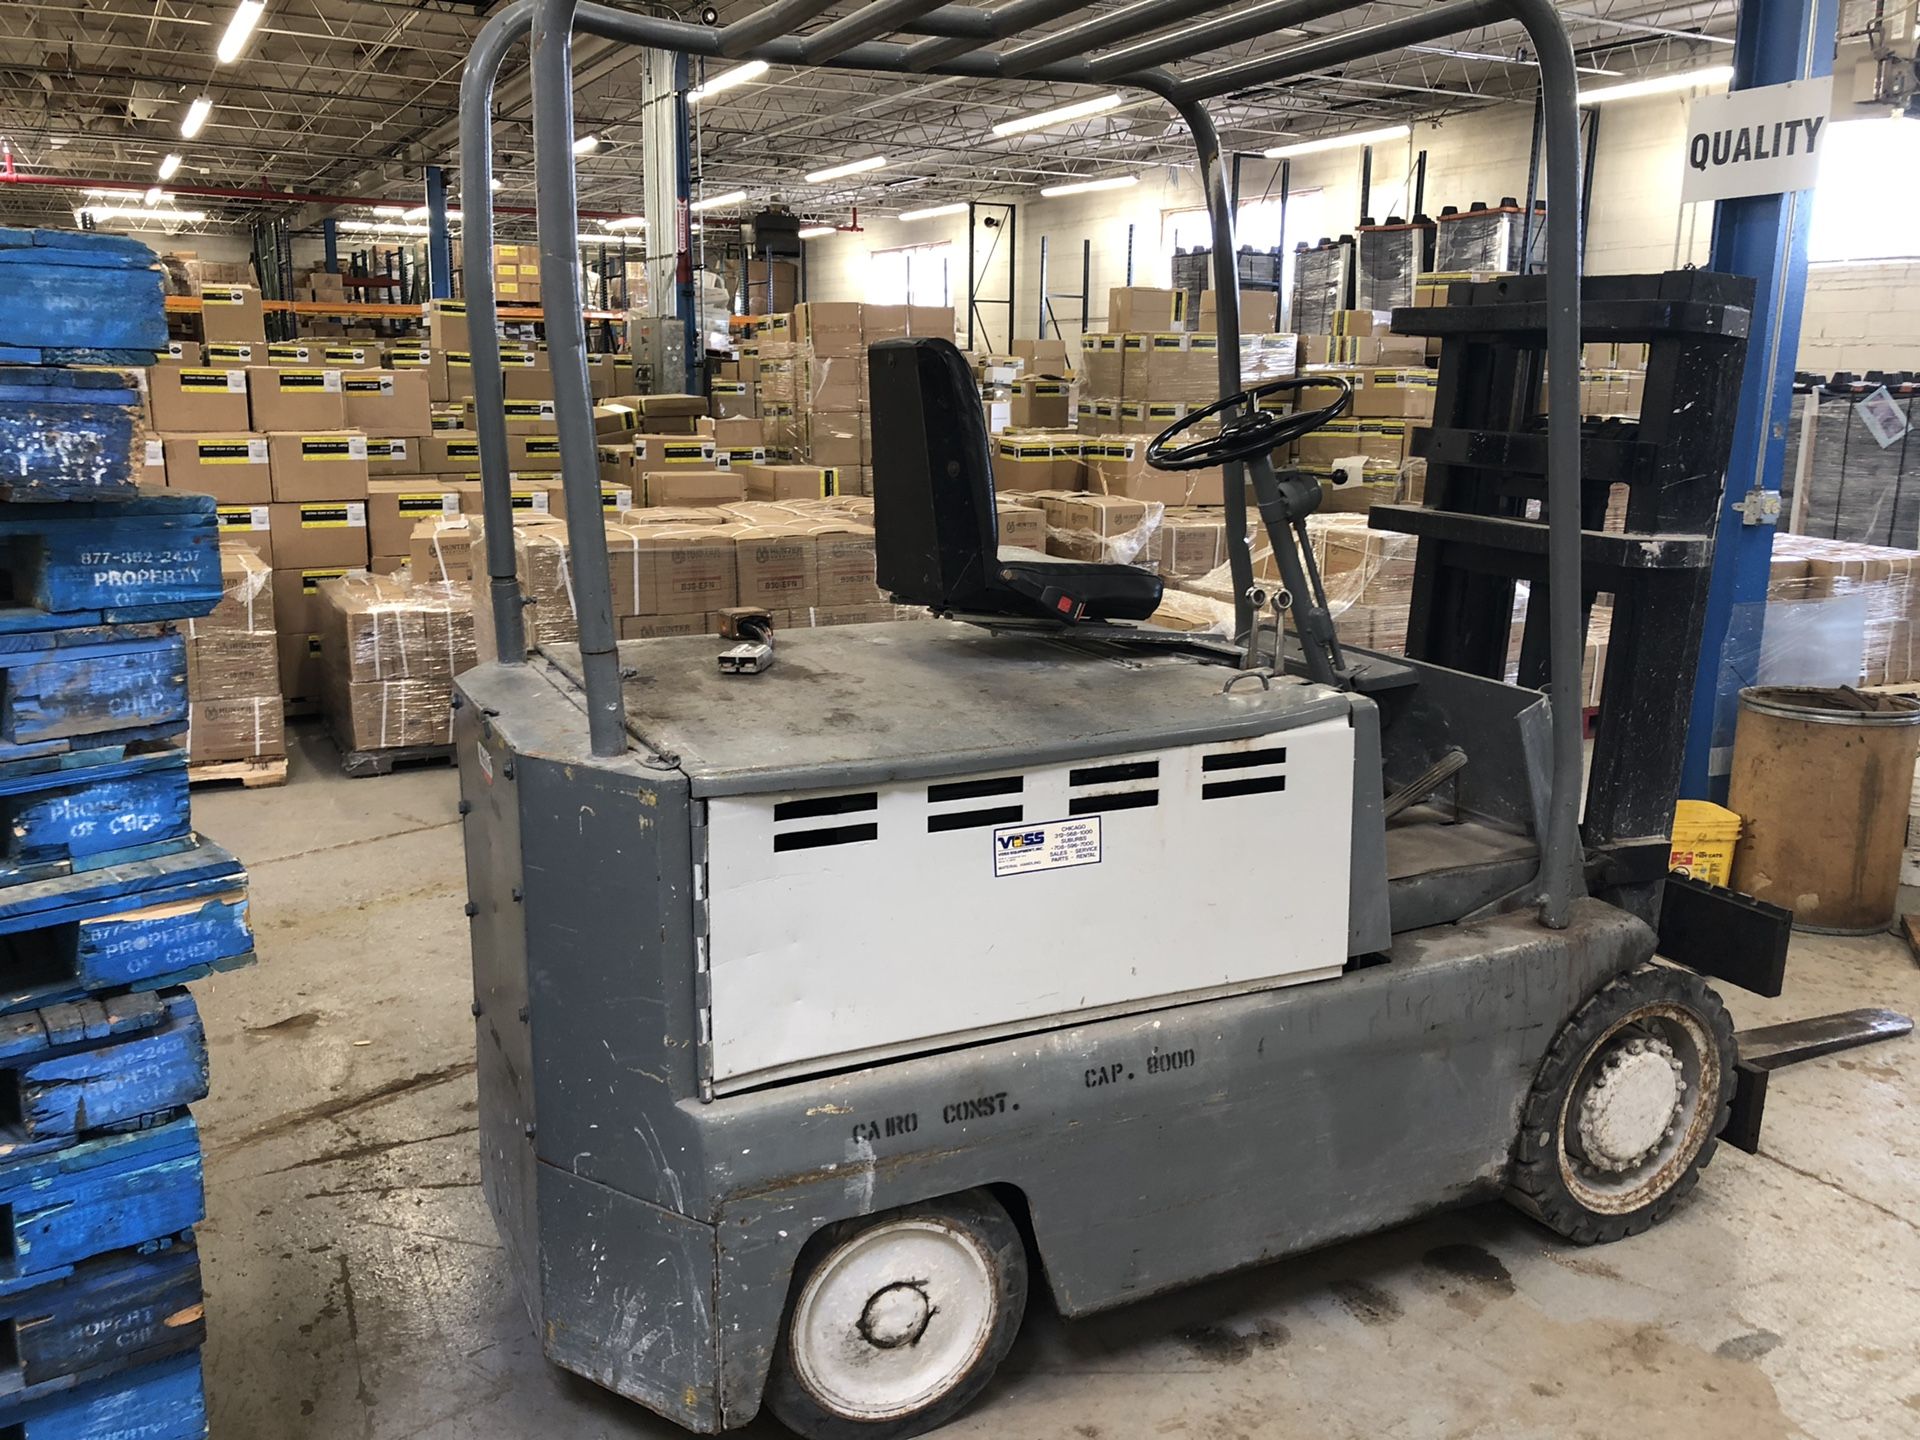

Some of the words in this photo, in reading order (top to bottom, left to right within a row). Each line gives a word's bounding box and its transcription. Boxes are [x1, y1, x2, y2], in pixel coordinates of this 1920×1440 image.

[1690, 116, 1824, 172] QUALITY
[94, 566, 201, 586] PROPERTY
[109, 812, 161, 835] CHEP
[1061, 824, 1087, 832] CHICAGO
[997, 831, 1045, 849] VOSS
[1075, 846, 1098, 854] SERVICE
[1085, 1063, 1135, 1089] CAP.
[852, 1112, 919, 1144] CAIRO
[943, 1092, 1020, 1125] CONST.
